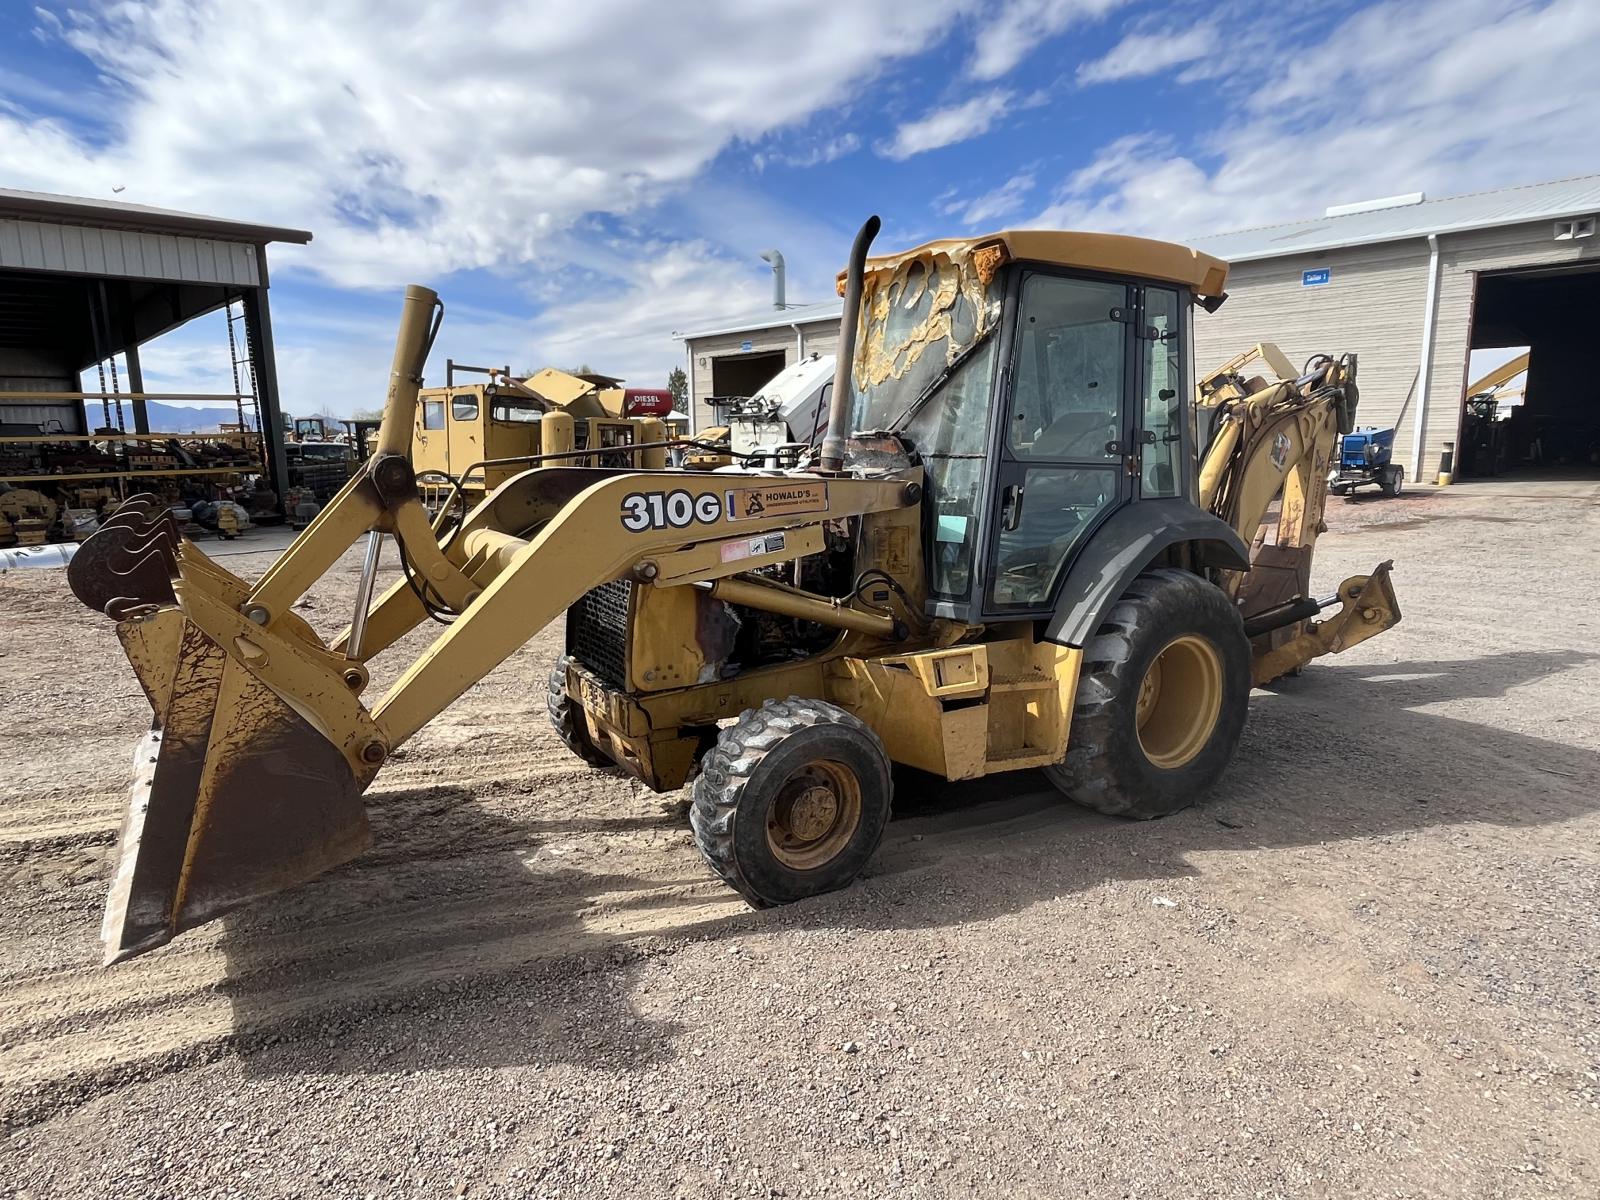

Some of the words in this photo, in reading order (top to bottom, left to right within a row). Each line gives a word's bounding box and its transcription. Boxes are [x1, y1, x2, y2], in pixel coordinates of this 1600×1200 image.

[634, 395, 660, 403] DIESEL
[766, 490, 811, 501] HOWALD'S
[621, 489, 722, 533] 310G
